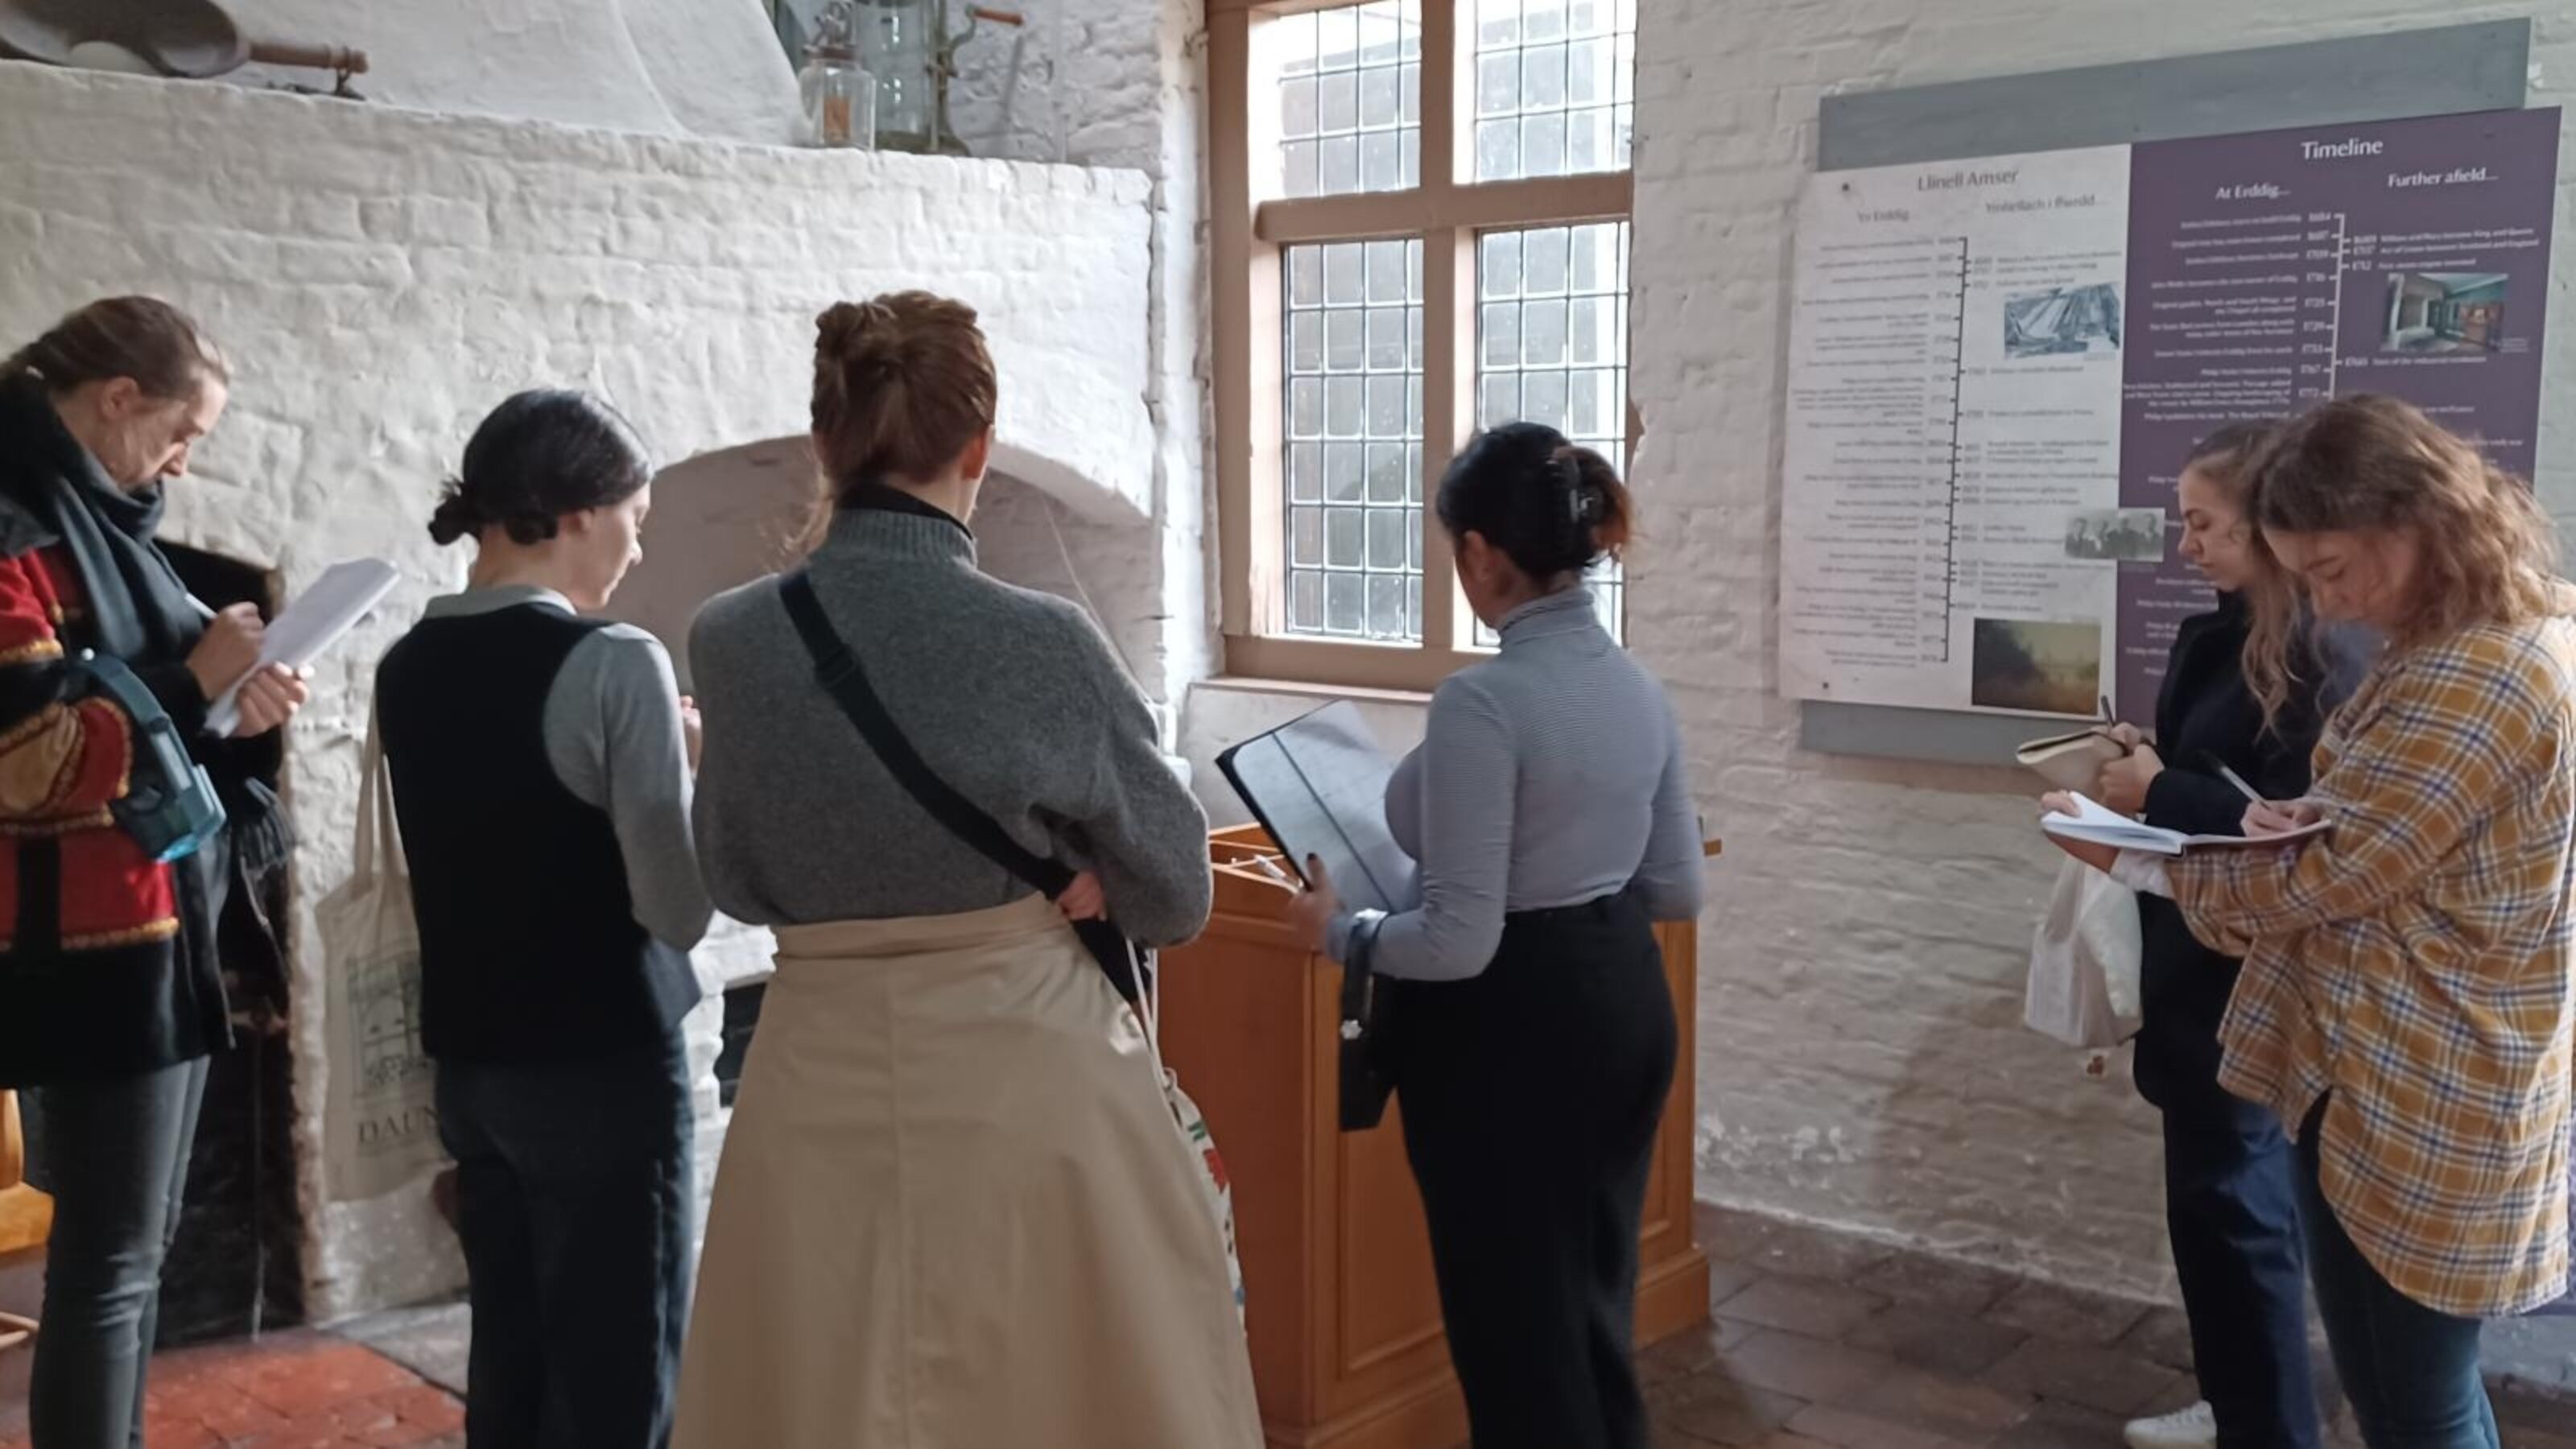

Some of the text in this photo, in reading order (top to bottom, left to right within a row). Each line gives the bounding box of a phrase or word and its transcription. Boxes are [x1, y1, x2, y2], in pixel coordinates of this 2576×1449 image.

[2301, 138, 2384, 159] Timeline
[1967, 169, 2020, 187] Amser
[2388, 170, 2442, 188] Further
[2215, 187, 2231, 200] At
